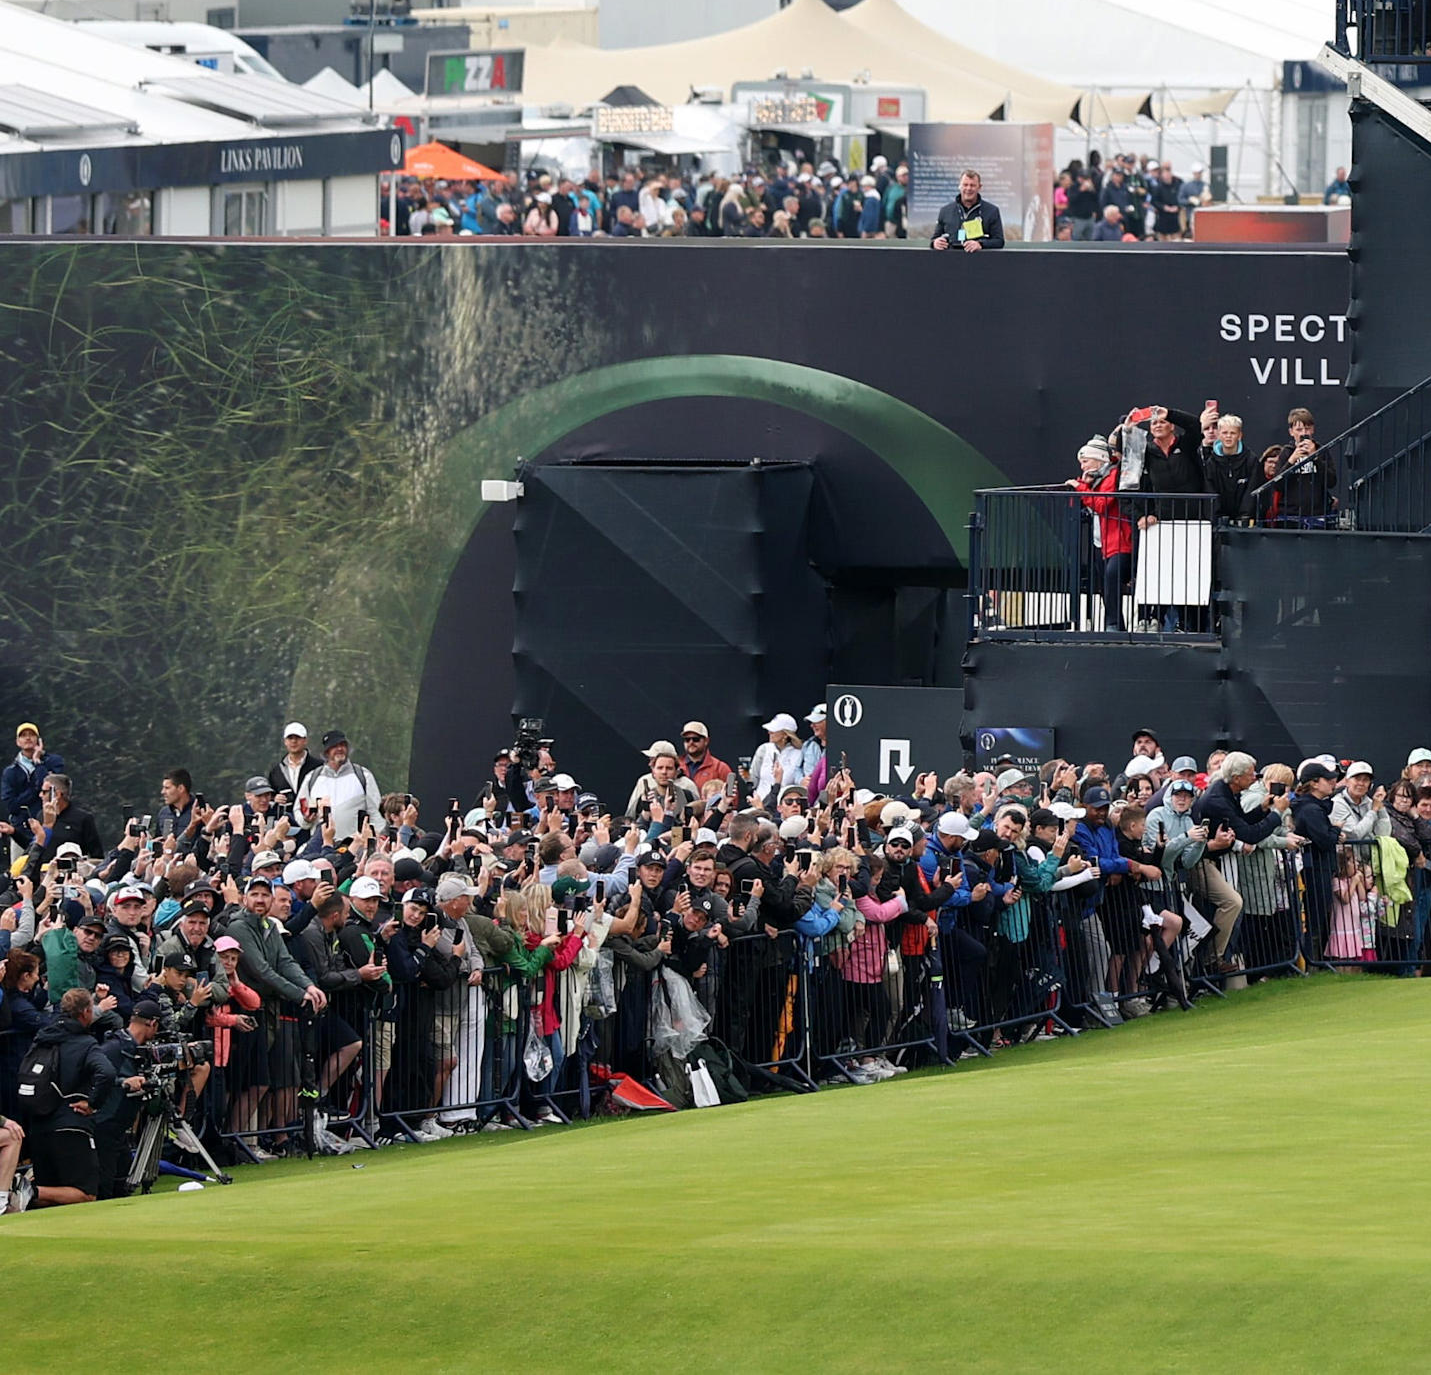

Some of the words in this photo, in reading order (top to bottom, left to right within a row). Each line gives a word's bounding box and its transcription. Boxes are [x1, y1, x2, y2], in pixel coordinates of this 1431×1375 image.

[443, 55, 507, 92] PIZZA
[220, 147, 252, 173] LINKS
[254, 144, 304, 170] PAVILION
[1219, 313, 1348, 343] SPECT
[1249, 357, 1341, 386] VILL
